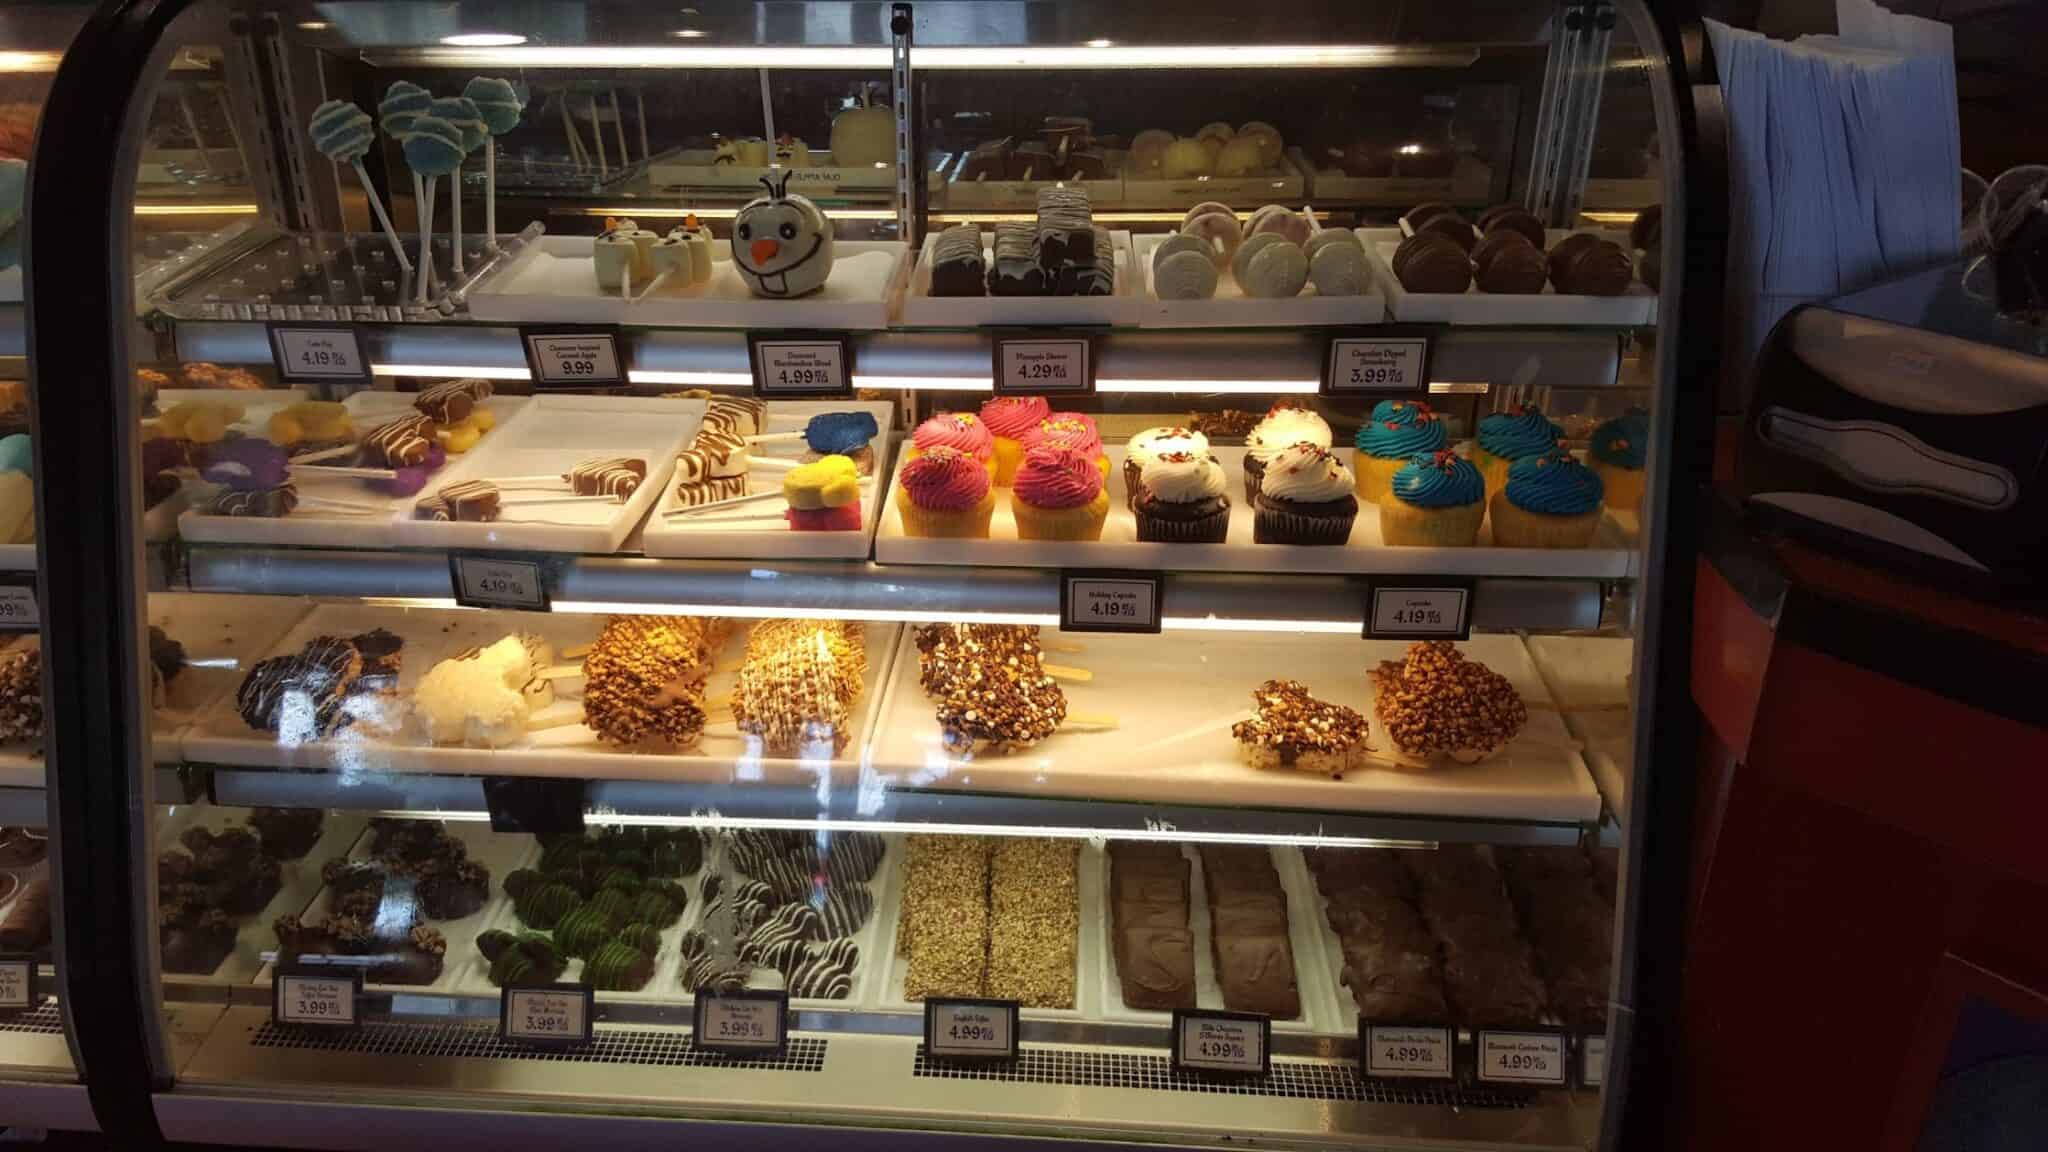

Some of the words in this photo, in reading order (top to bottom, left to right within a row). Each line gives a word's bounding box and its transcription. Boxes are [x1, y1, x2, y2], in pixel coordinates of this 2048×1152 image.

[302, 351, 329, 365] 4.19
[562, 360, 594, 375] 9.99
[1018, 364, 1052, 379] 4.29
[779, 369, 814, 384] 4.99
[1351, 368, 1387, 383] 3.99
[480, 578, 507, 593] 4.19
[1091, 601, 1120, 616] 4.19
[1391, 609, 1425, 624] 4.19
[296, 1000, 327, 1015] 3.99
[525, 1015, 556, 1031] 3.99
[720, 1021, 749, 1036] 3.99
[949, 1025, 980, 1040] 4.99
[1199, 1041, 1231, 1058] 4.99
[1385, 1047, 1419, 1062] 4.99
[1498, 1054, 1532, 1069] 4.99
